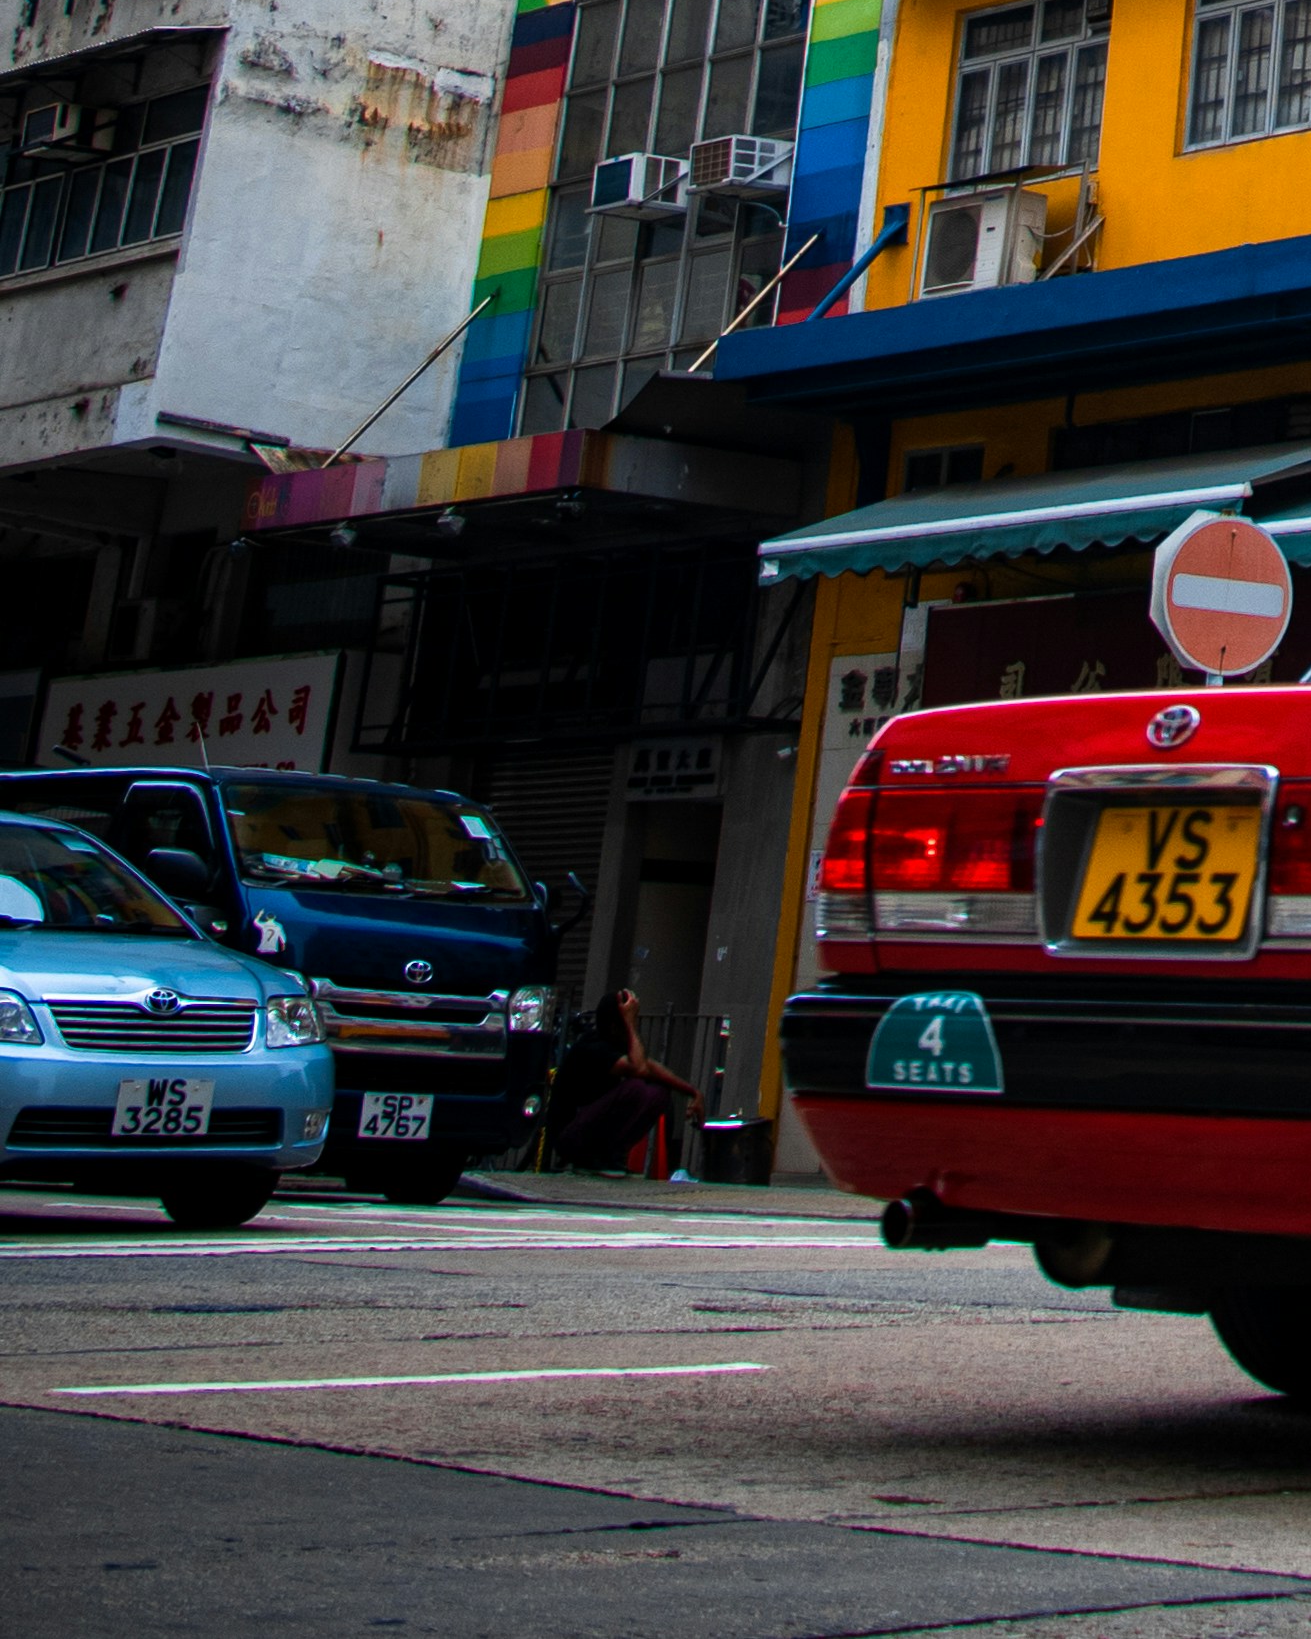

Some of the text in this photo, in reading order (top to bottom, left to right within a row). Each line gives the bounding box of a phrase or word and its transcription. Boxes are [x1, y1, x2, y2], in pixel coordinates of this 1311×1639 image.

[1147, 809, 1213, 871] VS
[1087, 872, 1239, 935] 4353
[917, 1015, 946, 1057] 4
[892, 1060, 974, 1084] SEATS
[147, 1078, 188, 1107] WS
[382, 1094, 413, 1117] SP
[120, 1106, 204, 1135] 3285
[363, 1114, 427, 1138] 4767
